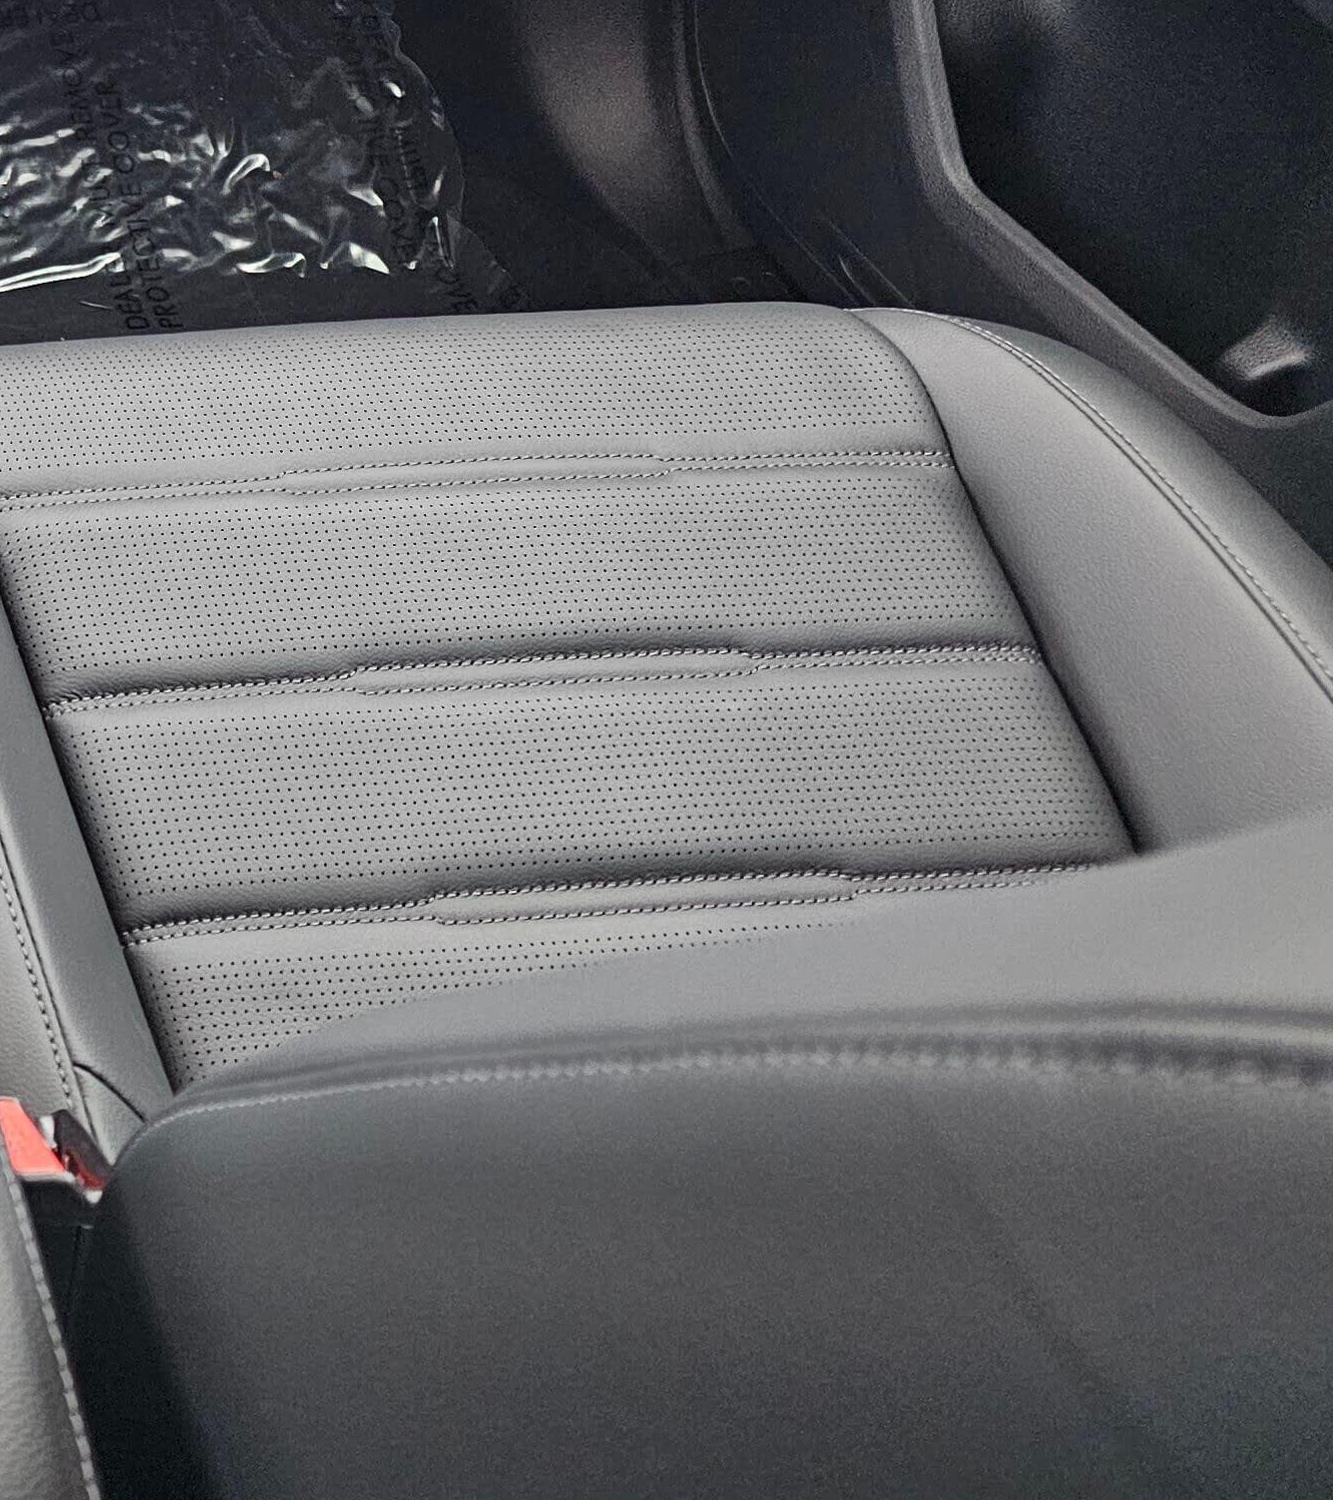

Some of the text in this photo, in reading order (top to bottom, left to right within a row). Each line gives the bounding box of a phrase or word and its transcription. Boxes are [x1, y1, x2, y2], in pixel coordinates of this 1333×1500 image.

[48, 29, 97, 143] REMOVE
[94, 80, 183, 330] PROTECTIVE COVER
